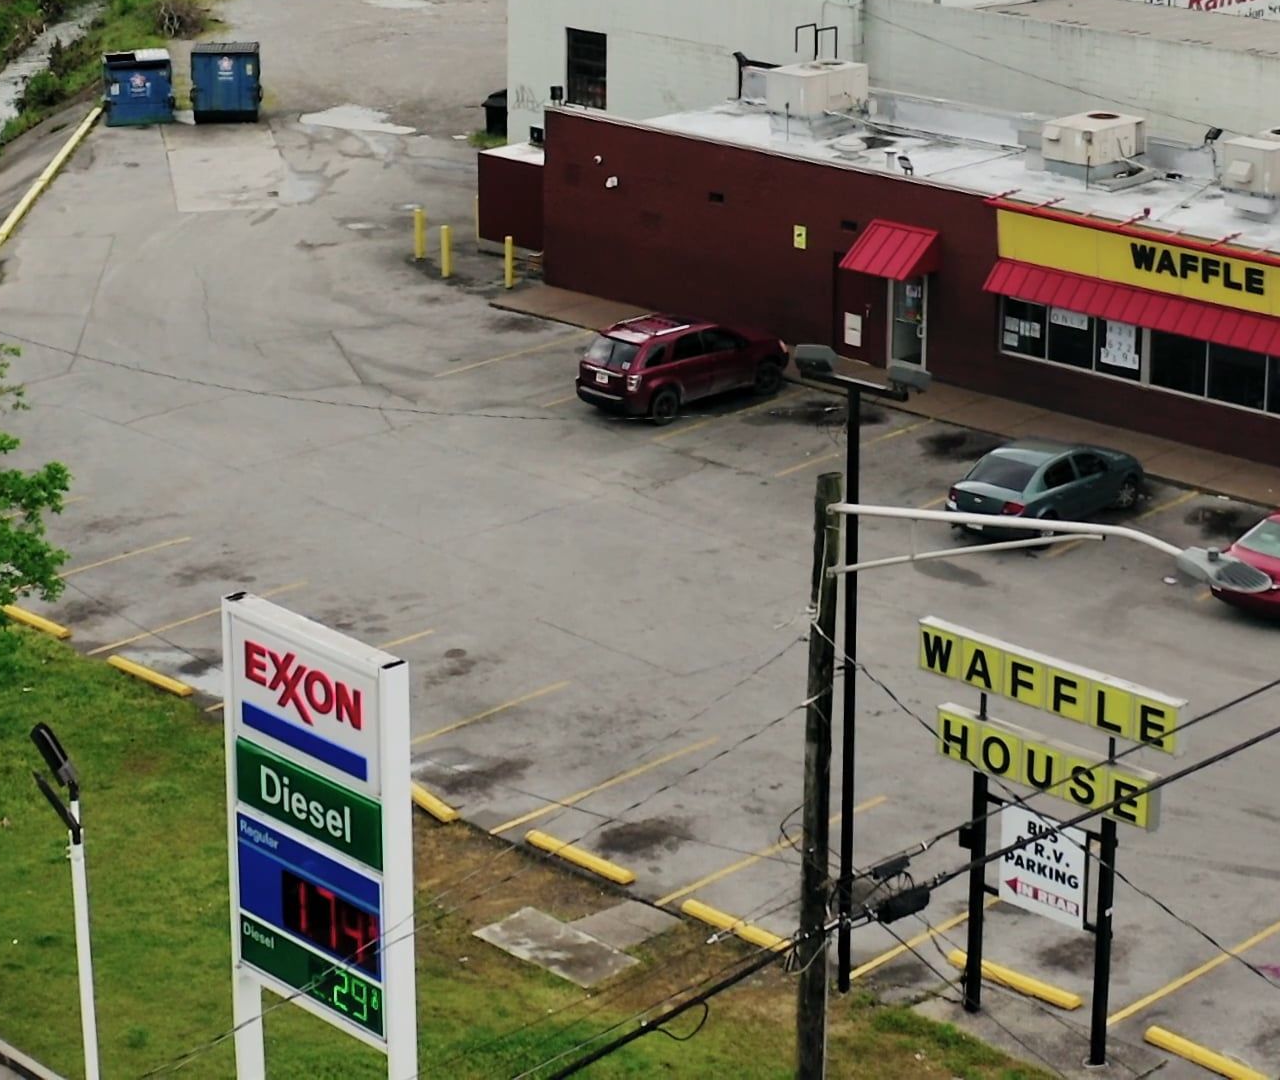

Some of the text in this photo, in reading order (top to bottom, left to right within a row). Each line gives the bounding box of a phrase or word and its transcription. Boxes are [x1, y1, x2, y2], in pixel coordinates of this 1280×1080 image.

[1130, 243, 1264, 295] WAFFLE
[244, 639, 362, 730] EXXON
[922, 631, 1166, 747] WAFFLE
[942, 719, 1138, 822] HOUSE
[260, 764, 352, 844] Diesel
[240, 819, 279, 850] Regular
[1027, 820, 1058, 844] BUS
[1005, 851, 1079, 890] PARKING
[1034, 842, 1070, 868] R.V.
[243, 921, 275, 950] Diesel
